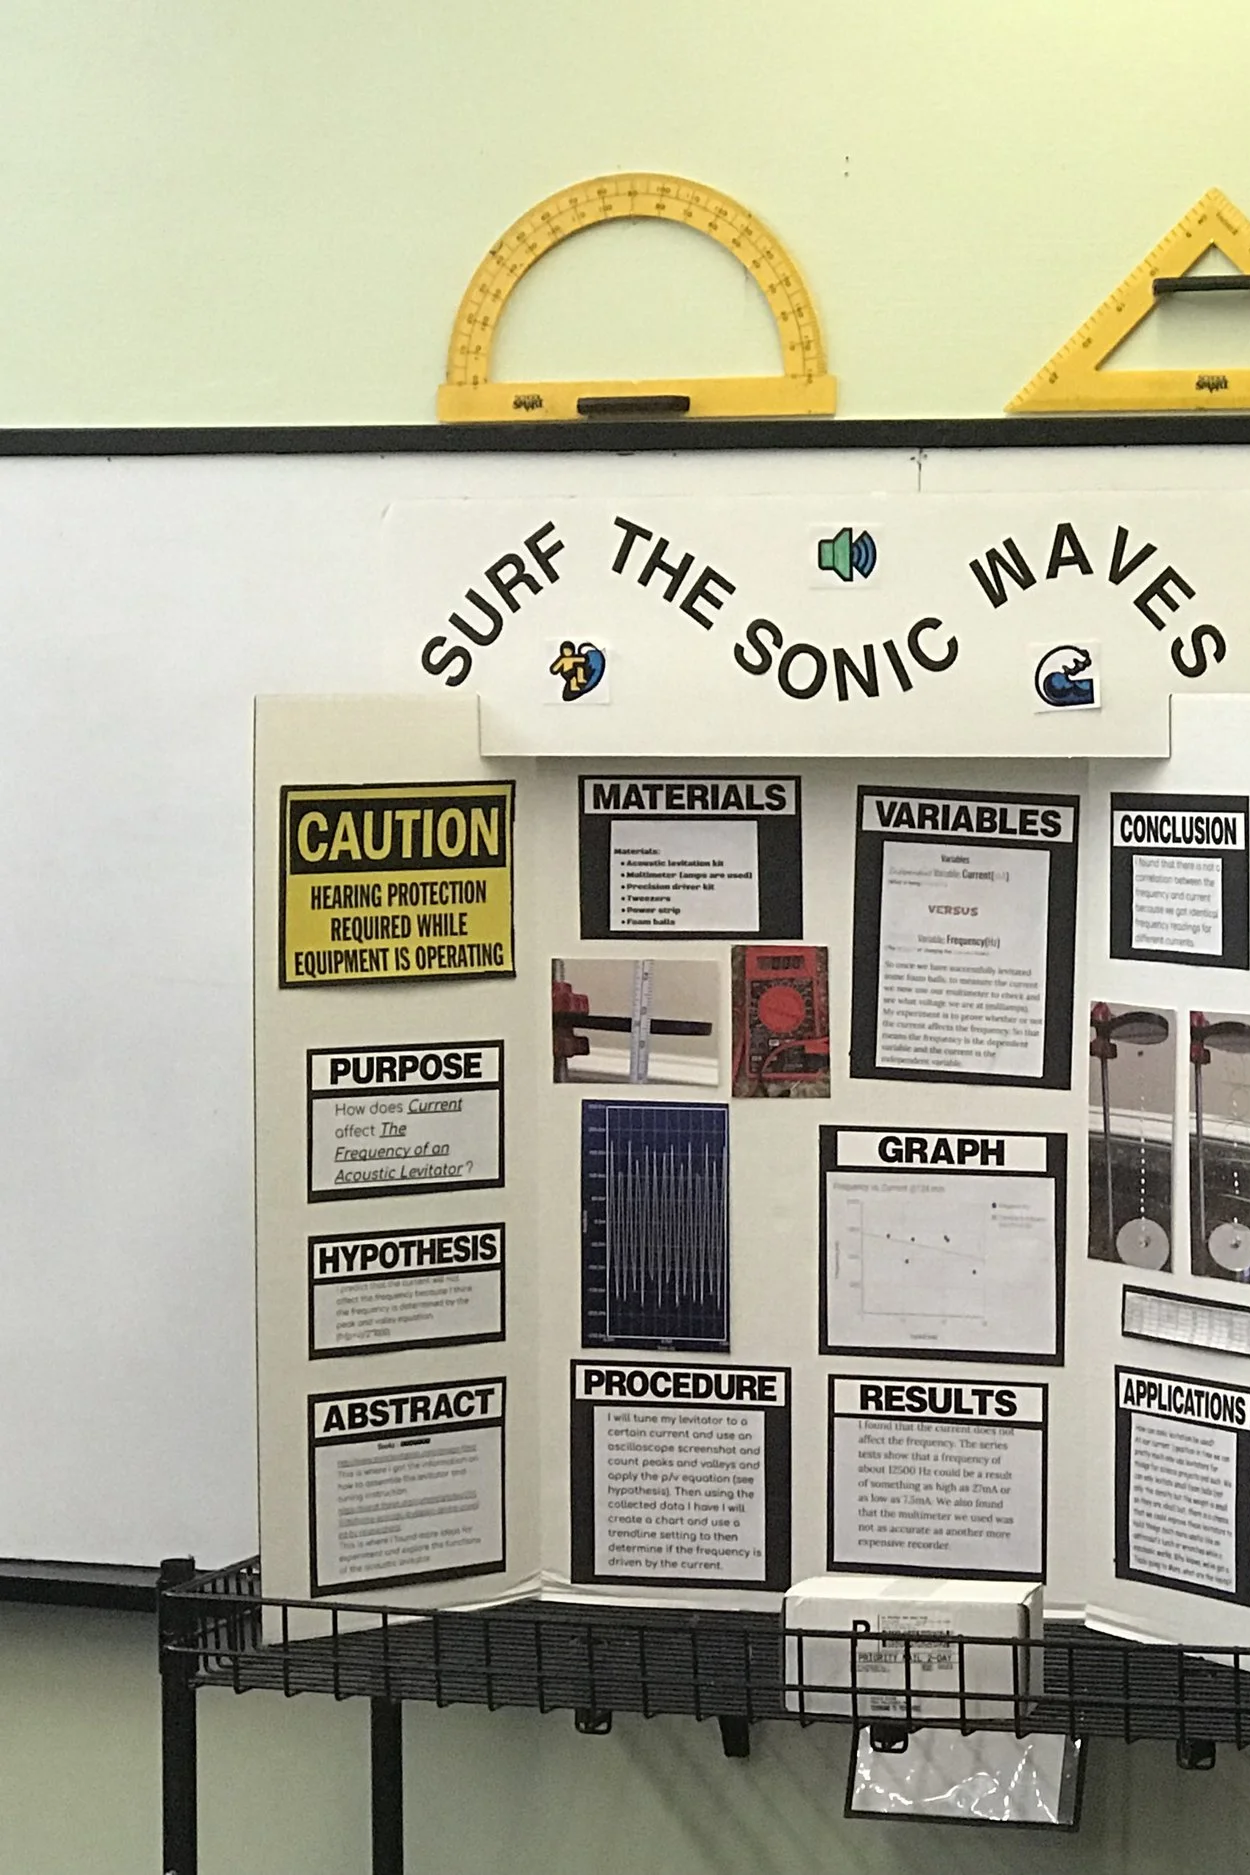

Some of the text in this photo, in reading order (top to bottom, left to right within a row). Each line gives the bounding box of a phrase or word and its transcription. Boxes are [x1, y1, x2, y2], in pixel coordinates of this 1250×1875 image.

[420, 516, 1227, 701] SURF THE SONIC WAVES
[593, 783, 787, 811] MATERIALS
[875, 800, 1062, 838] VARIABLES
[1120, 814, 1237, 845] CONCLUSION
[297, 807, 499, 863] CAUTION
[311, 880, 487, 910] HEARING PROTECTION
[928, 904, 979, 917] VERSUS
[331, 912, 468, 943] REQUIRED WHILE
[294, 942, 504, 978] EQUIPMENT IS OPERATING
[330, 1052, 482, 1085] PURPOSE
[335, 1098, 463, 1117] How does Current
[335, 1122, 407, 1139] affect The
[335, 1141, 450, 1162] Frequency of an
[878, 1135, 1006, 1166] GRAPH
[335, 1166, 396, 1183] Acoustic
[319, 1233, 497, 1274] HYPOTHESIS
[584, 1369, 777, 1401] PROCEDURE
[322, 1388, 495, 1433] ABSTRACT
[860, 1384, 1017, 1417] RESULTS
[1123, 1378, 1246, 1426] APPLICATIONS
[613, 1412, 631, 1422] will
[633, 1413, 658, 1424] tune
[661, 1415, 677, 1426] my
[679, 1415, 723, 1426] levitator
[727, 1417, 738, 1426] to
[607, 1427, 752, 1441] certain current and use an
[608, 1441, 760, 1456] oscilloscope screenshot and
[608, 1457, 760, 1472] count peaks and valleys and
[608, 1471, 754, 1486] apply the p/v equation (see
[675, 1485, 702, 1497] Then
[704, 1487, 734, 1501] using
[737, 1488, 754, 1499] the
[608, 1499, 657, 1511] collected
[660, 1500, 685, 1512] data
[694, 1501, 719, 1513] have
[728, 1503, 745, 1513] will
[608, 1515, 642, 1525] create
[655, 1515, 684, 1526] chart
[687, 1516, 708, 1527] and
[711, 1518, 730, 1528] use
[608, 1528, 738, 1543] trendline setting to then
[608, 1543, 762, 1559] determine if the frequency is
[608, 1557, 642, 1568] driven
[645, 1558, 658, 1570] by
[660, 1558, 678, 1568] the
